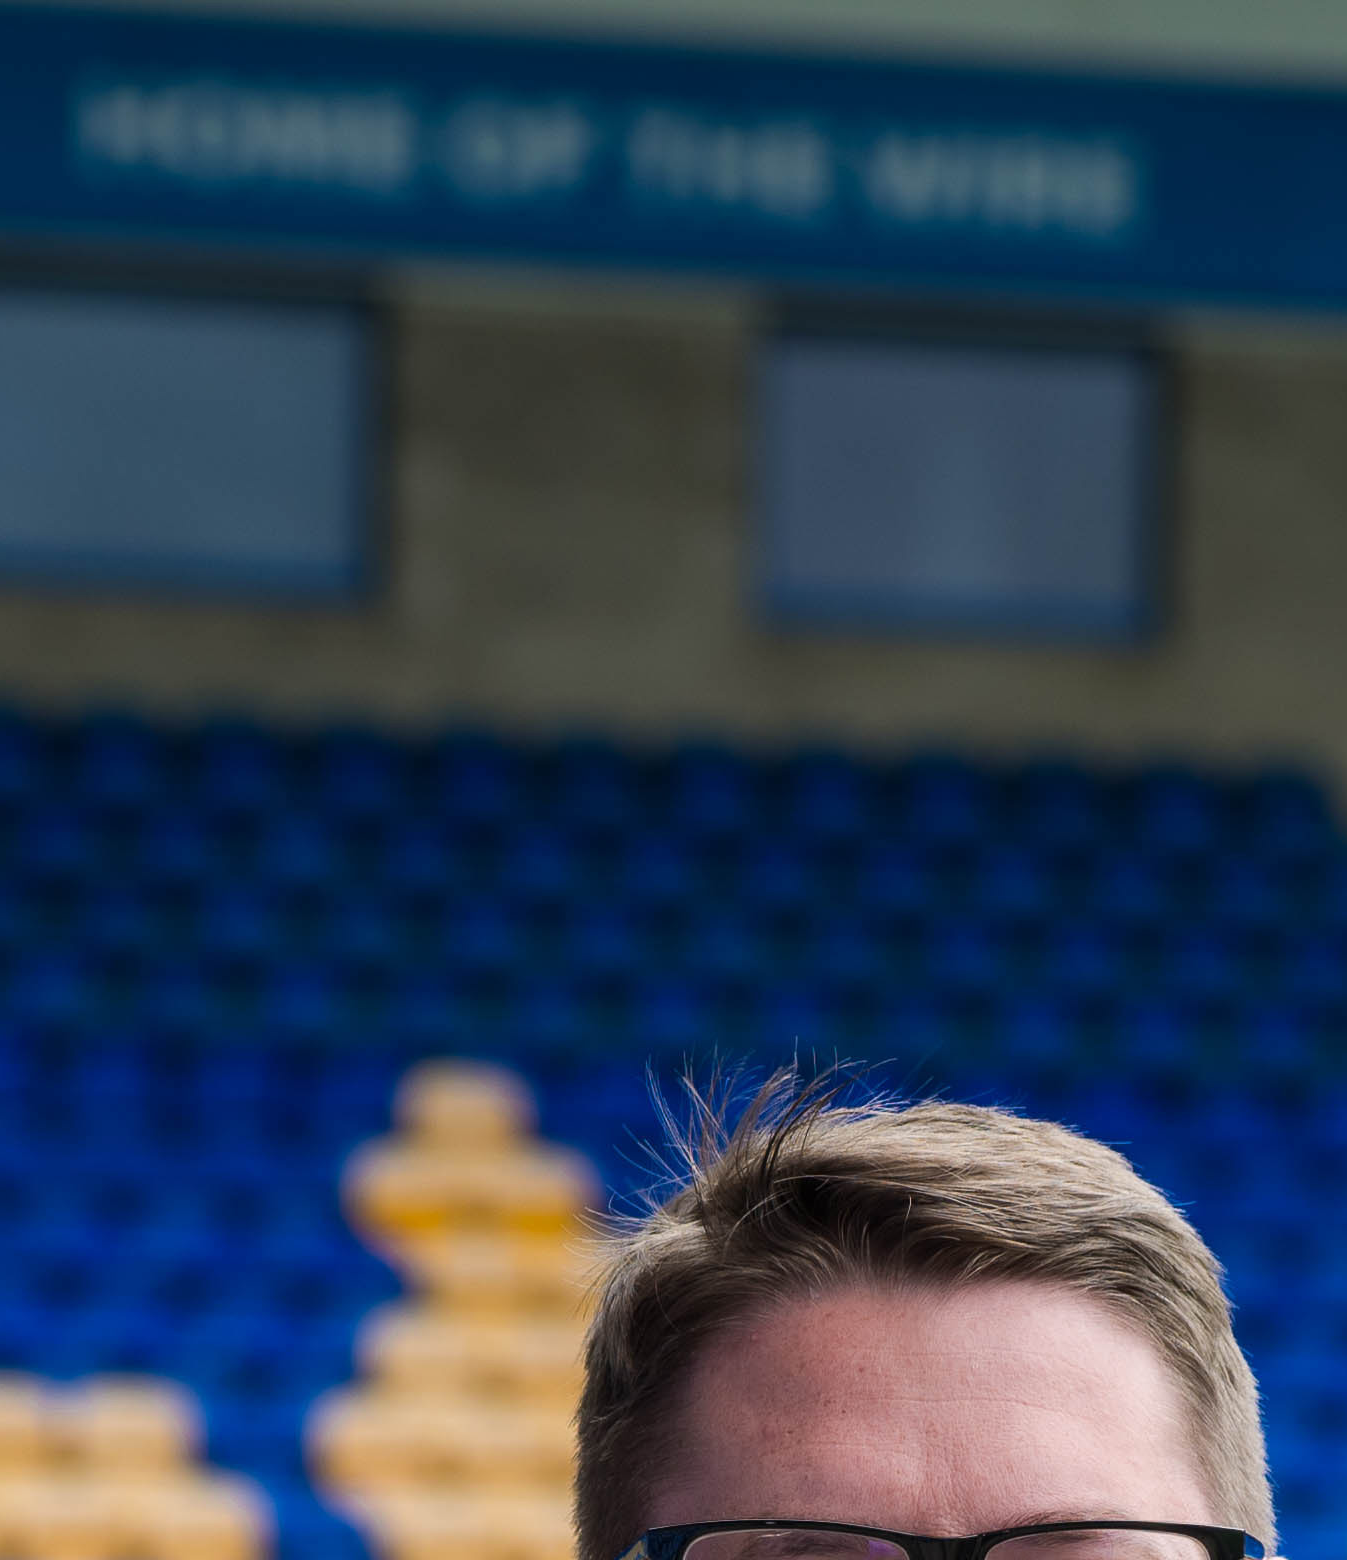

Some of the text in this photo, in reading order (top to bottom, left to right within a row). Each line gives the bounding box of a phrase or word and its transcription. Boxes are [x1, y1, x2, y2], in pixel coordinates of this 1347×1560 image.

[72, 80, 1140, 236] HOME OF THE WIRE
